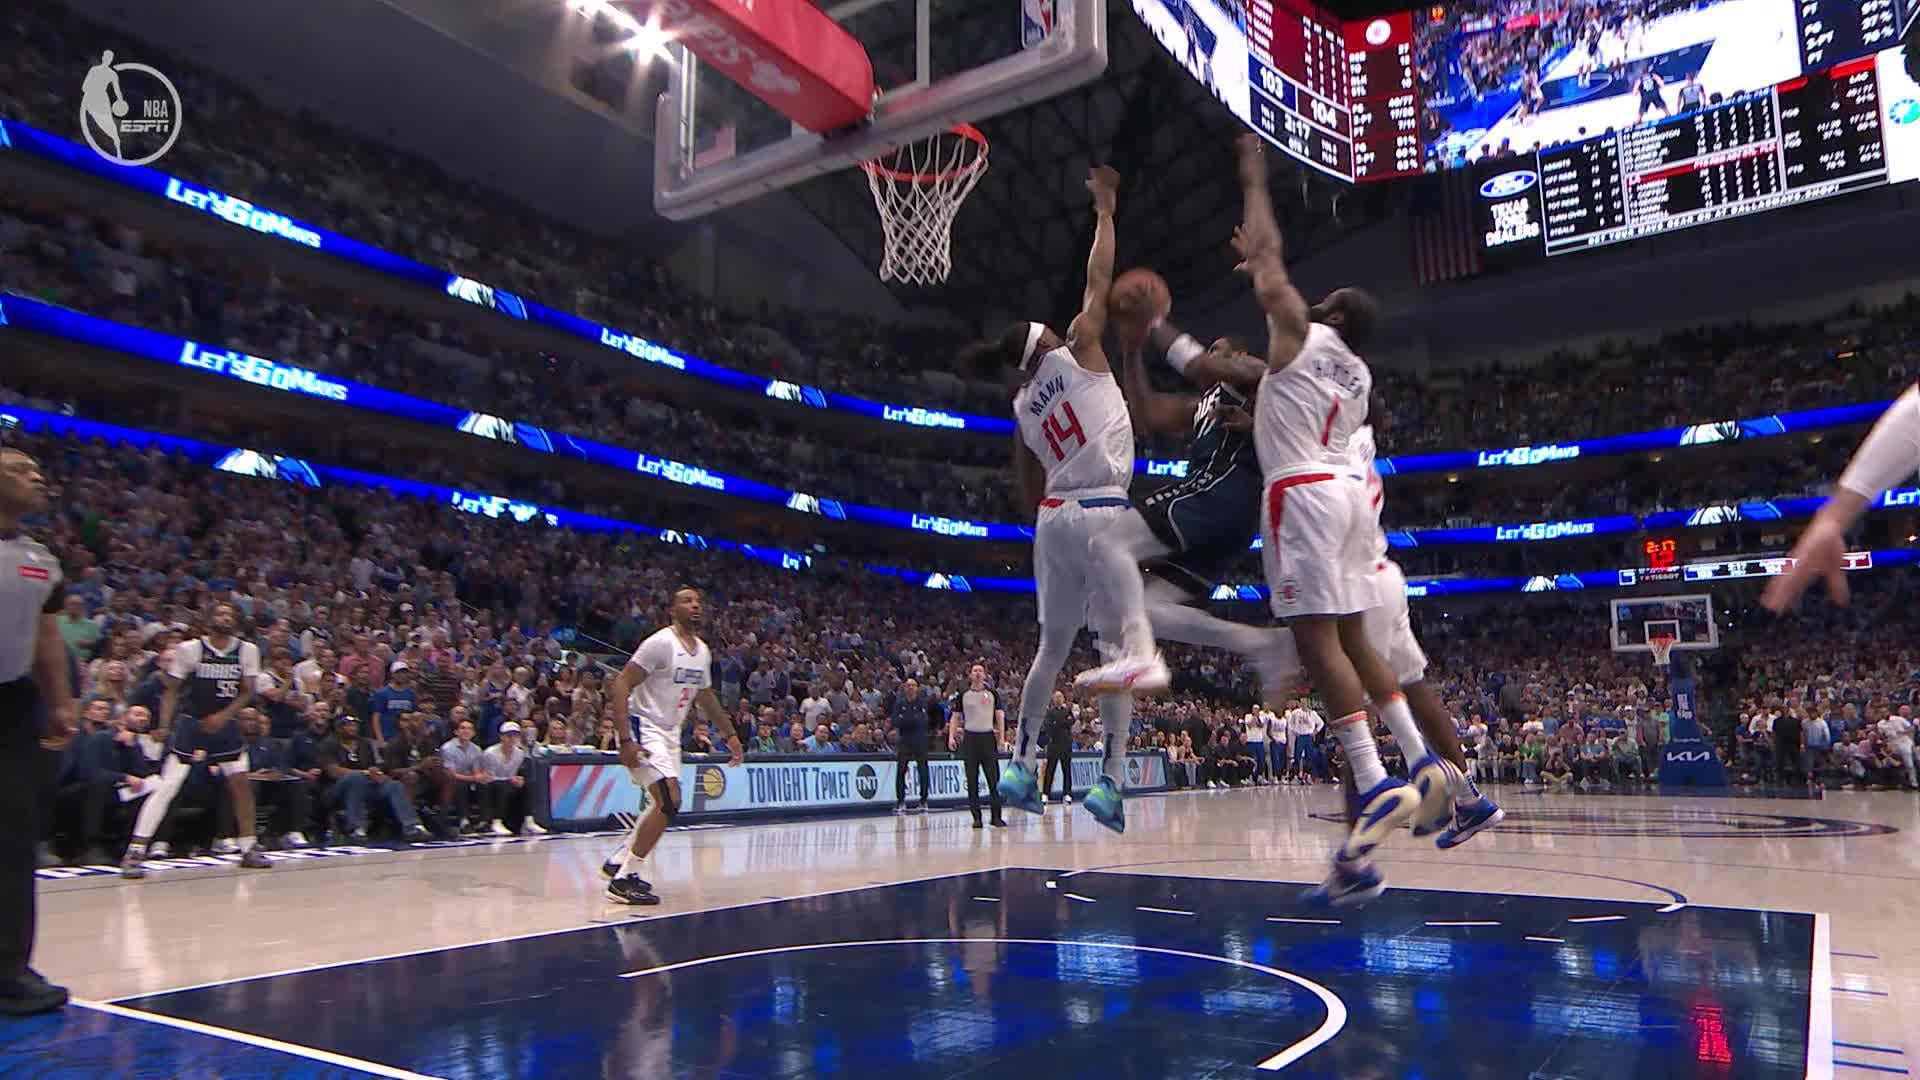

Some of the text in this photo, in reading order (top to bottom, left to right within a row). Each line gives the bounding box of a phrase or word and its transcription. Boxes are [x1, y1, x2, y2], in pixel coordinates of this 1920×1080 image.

[1260, 66, 1284, 100] 103
[1310, 98, 1338, 129] 104
[1490, 197, 1529, 218] TEXAS
[1485, 221, 1540, 248] DEALERS
[1030, 375, 1065, 417] MANN
[1041, 400, 1087, 463] 14
[1321, 393, 1340, 447] 1
[1666, 751, 1711, 762] KIA
[746, 766, 809, 803] TONIGHT
[856, 776, 878, 791] TNT
[913, 765, 960, 795] PAYOFFS
